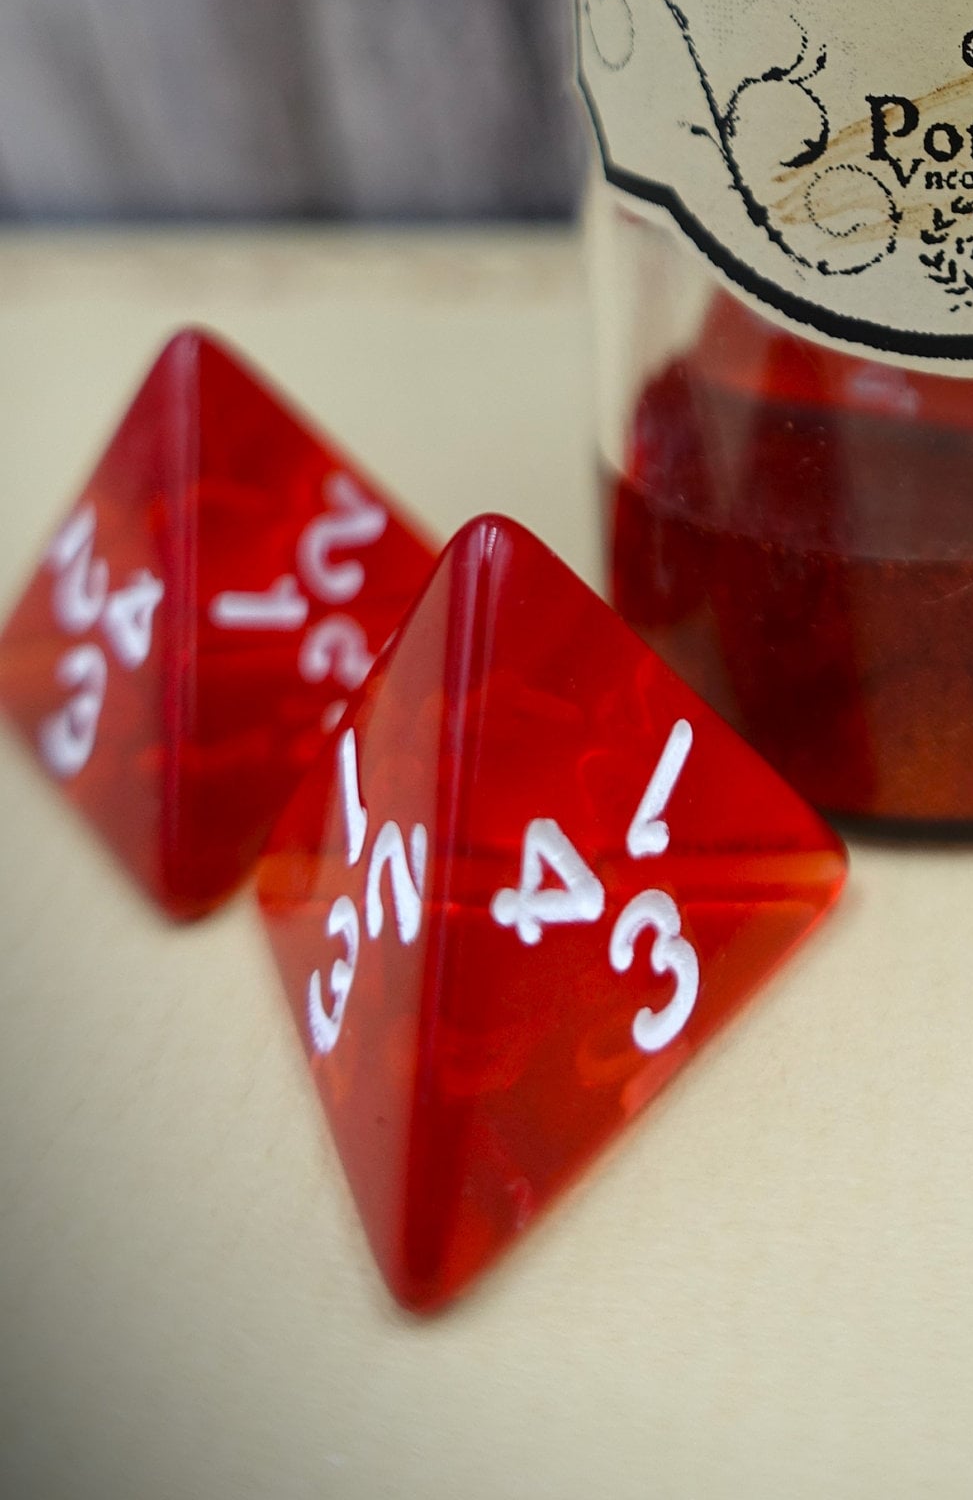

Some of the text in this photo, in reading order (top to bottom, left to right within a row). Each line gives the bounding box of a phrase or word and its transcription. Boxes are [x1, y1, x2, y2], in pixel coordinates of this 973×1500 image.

[208, 572, 309, 632] 1
[338, 726, 368, 867] 1
[626, 718, 694, 859] 1
[365, 819, 428, 945] 2
[490, 817, 606, 946] 4
[307, 894, 361, 1056] 3
[609, 888, 701, 1054] 3
